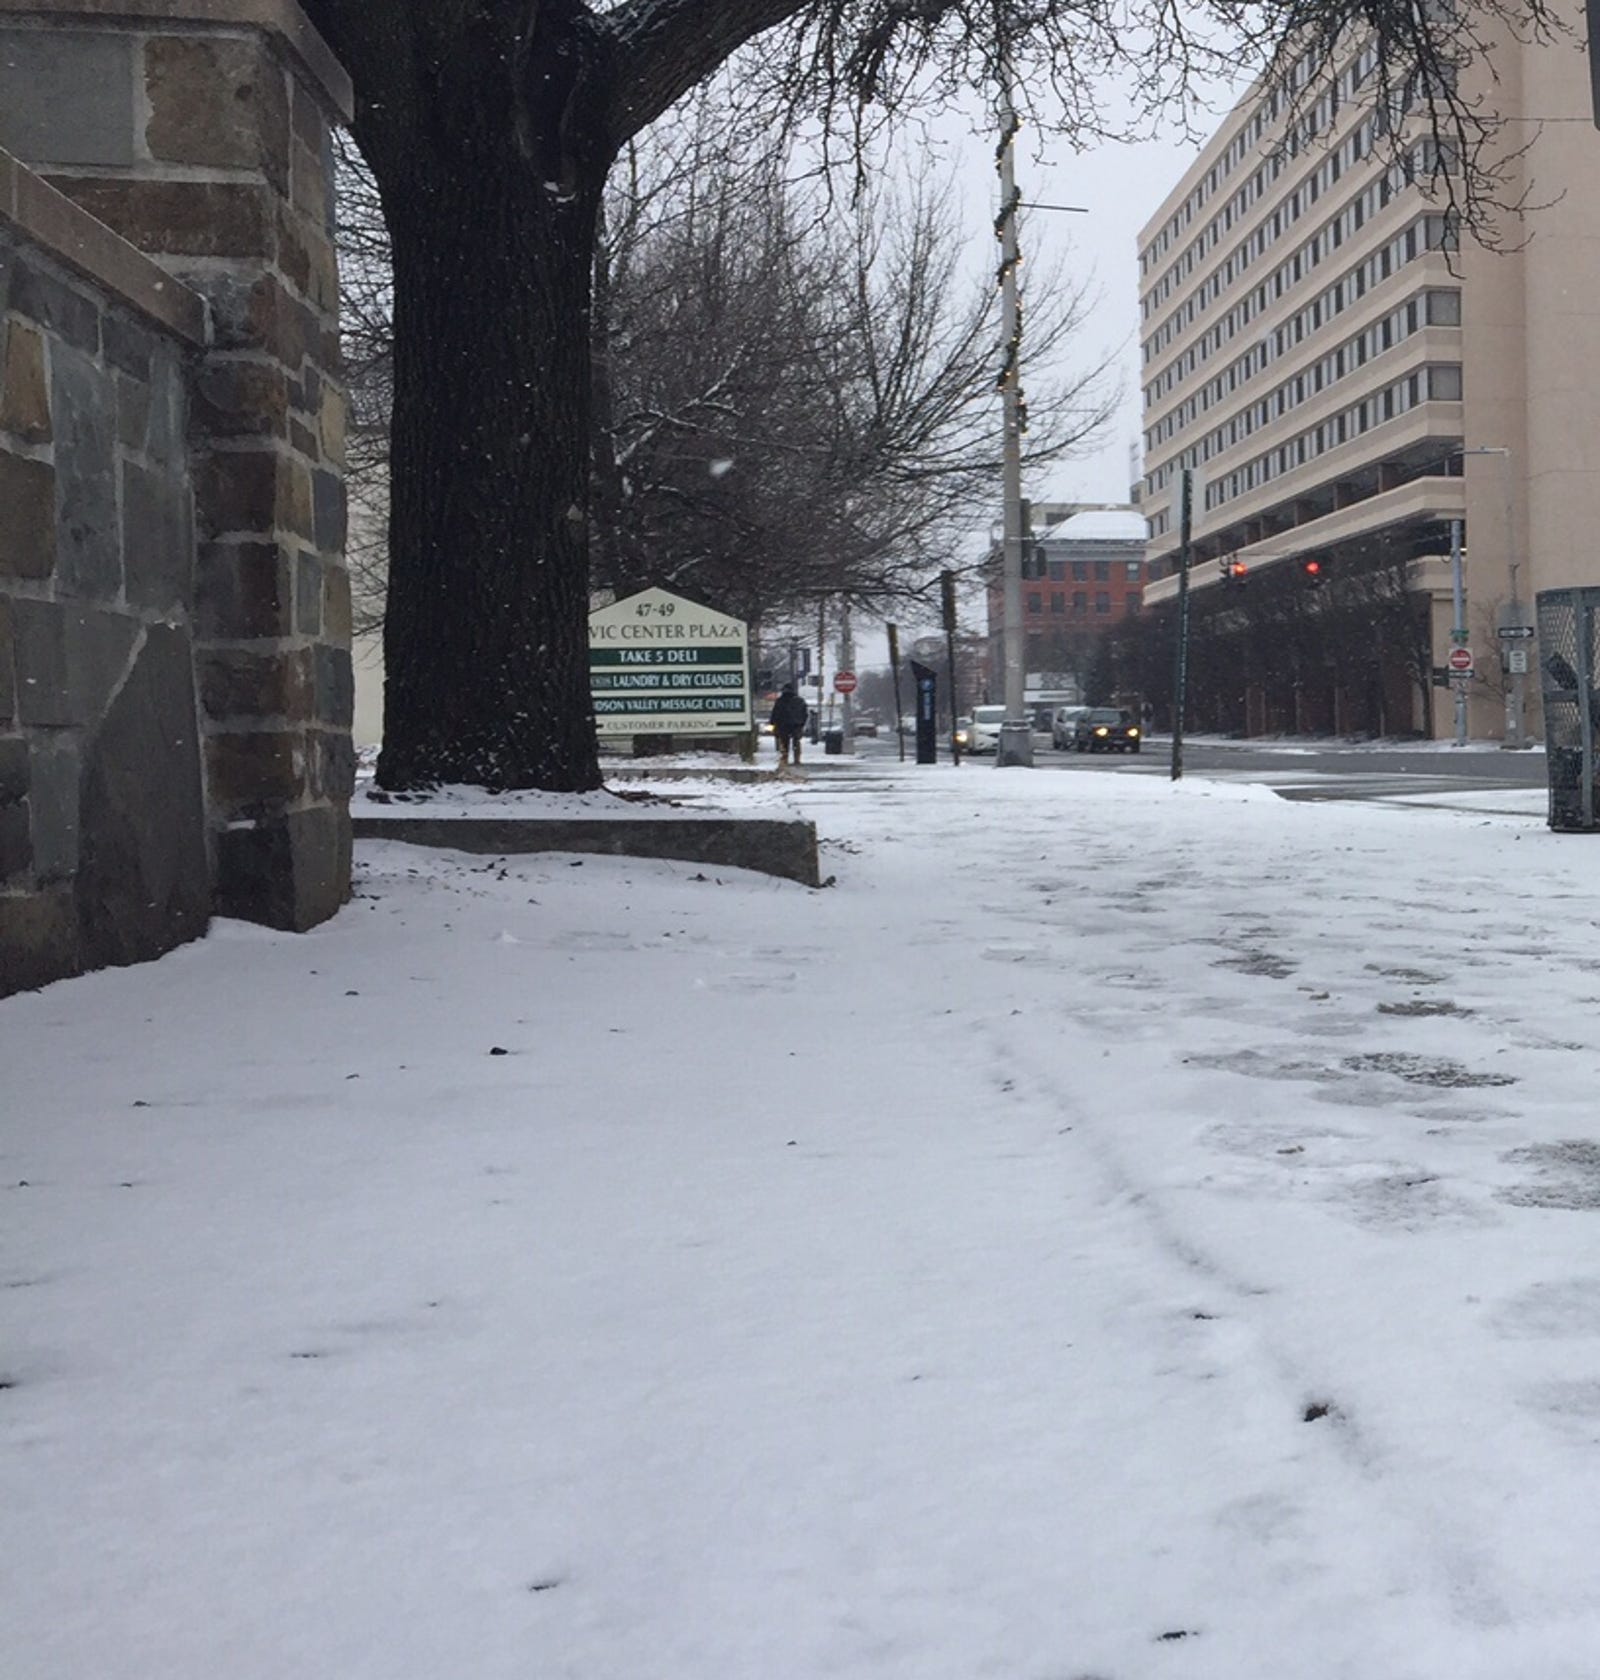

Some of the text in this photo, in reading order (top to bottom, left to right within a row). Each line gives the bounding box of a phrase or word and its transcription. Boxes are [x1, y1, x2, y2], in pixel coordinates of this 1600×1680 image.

[635, 603, 675, 617] 47-49
[588, 624, 742, 640] VIC CENTER PLAZA
[619, 650, 698, 663] TAKE 5 DELI
[613, 673, 661, 687] LAUNDRY
[662, 674, 670, 686] &
[671, 673, 692, 686] DRY
[693, 672, 742, 686] CLEANERS
[594, 696, 742, 712] DSON VALLEY MESSAGE CENTER
[606, 718, 714, 731] CUSTOMER PARKING
